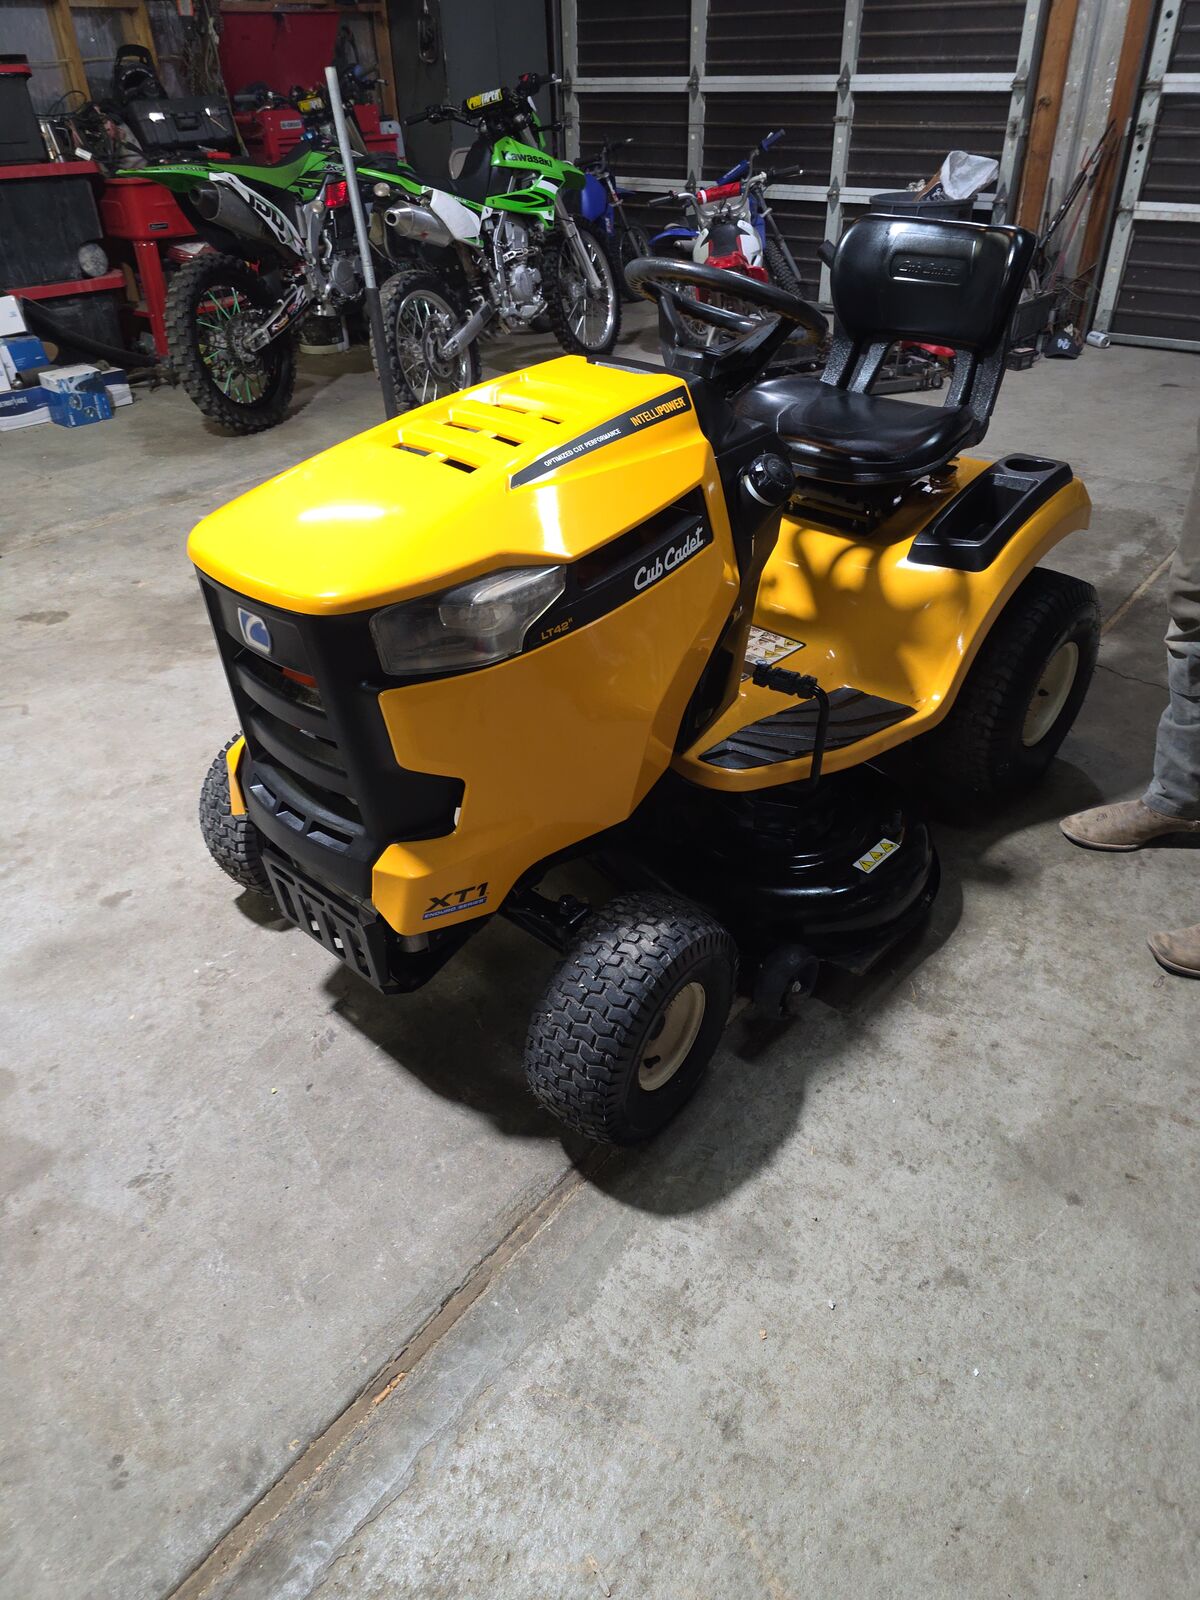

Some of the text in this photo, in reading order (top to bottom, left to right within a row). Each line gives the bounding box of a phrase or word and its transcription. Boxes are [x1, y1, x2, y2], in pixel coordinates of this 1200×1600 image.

[502, 150, 552, 167] Kawasaki
[630, 397, 686, 427] INTELLIPOWER
[544, 428, 622, 467] OPTIMIZED CUT PERFORMANCE
[633, 527, 704, 591] Cub Cadet
[541, 617, 573, 640] LT42"
[425, 882, 488, 912] XT1
